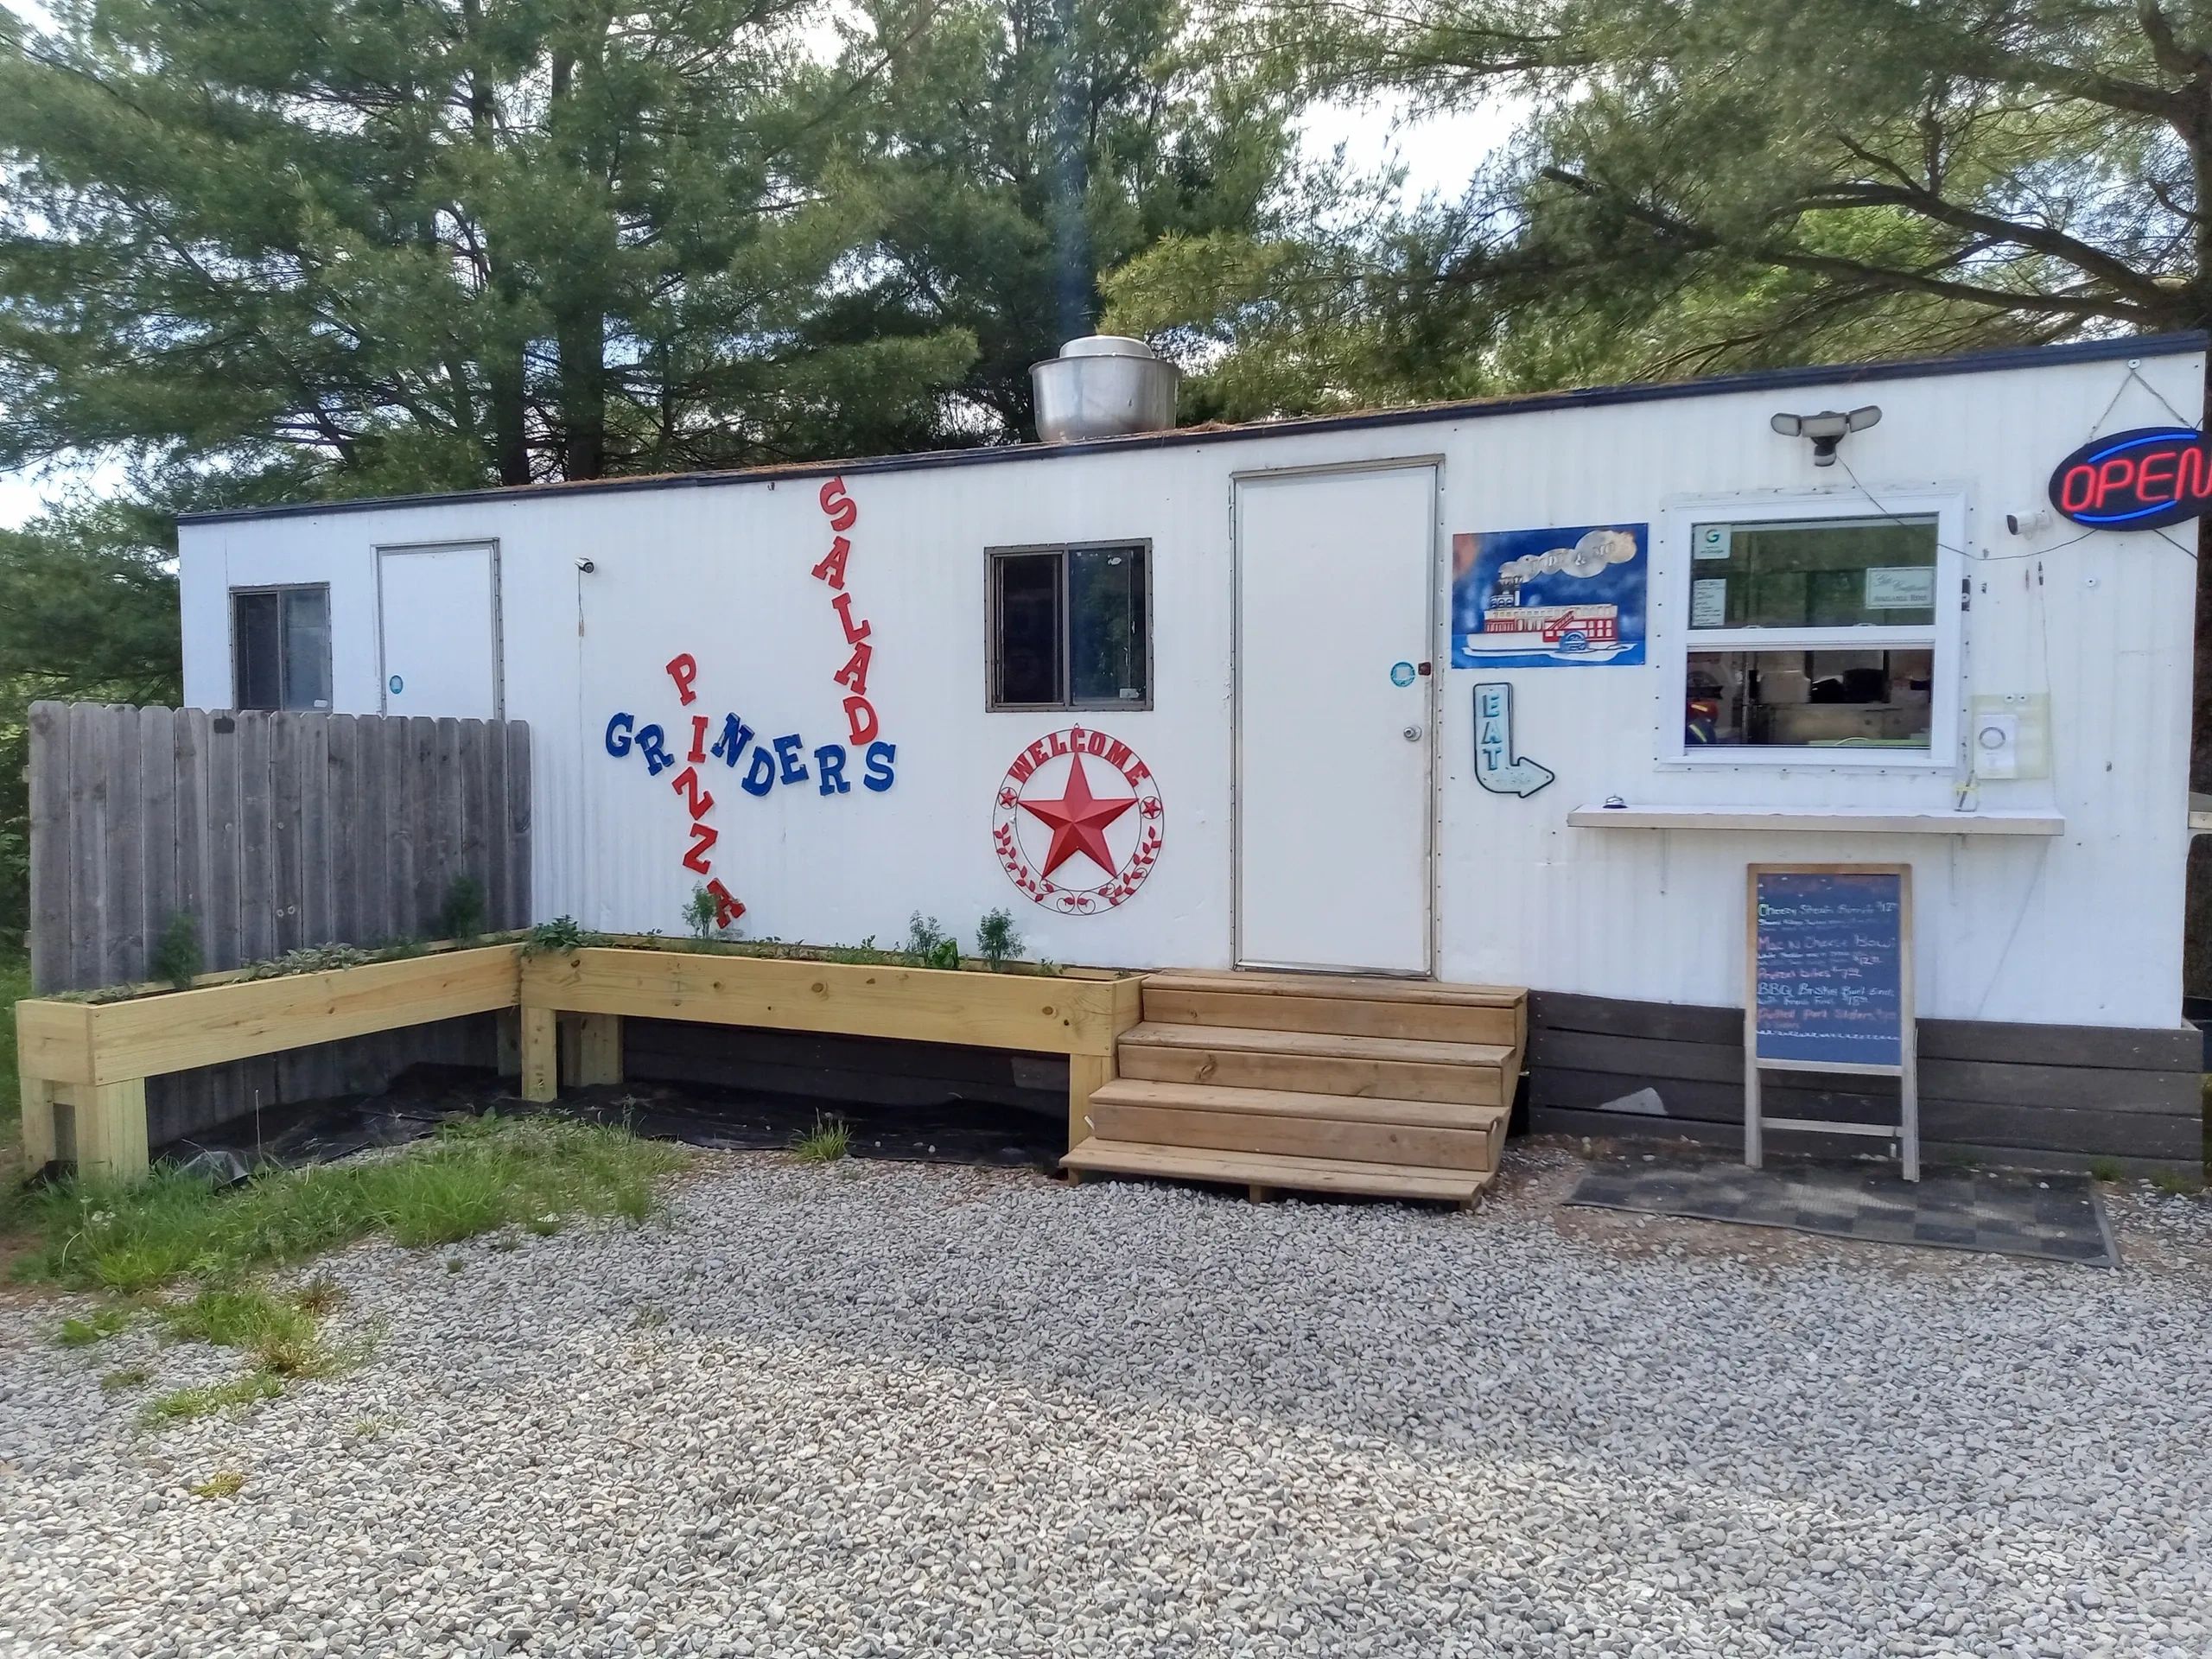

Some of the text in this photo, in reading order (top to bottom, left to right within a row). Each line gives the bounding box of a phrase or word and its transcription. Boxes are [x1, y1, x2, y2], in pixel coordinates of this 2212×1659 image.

[2061, 446, 2212, 513] OPEN
[605, 712, 897, 797] GRINDERS
[1008, 728, 1151, 788] WELCOME
[1480, 694, 1503, 772] EAT
[666, 653, 747, 931] PIZZA
[1758, 982, 1795, 997] BBQ
